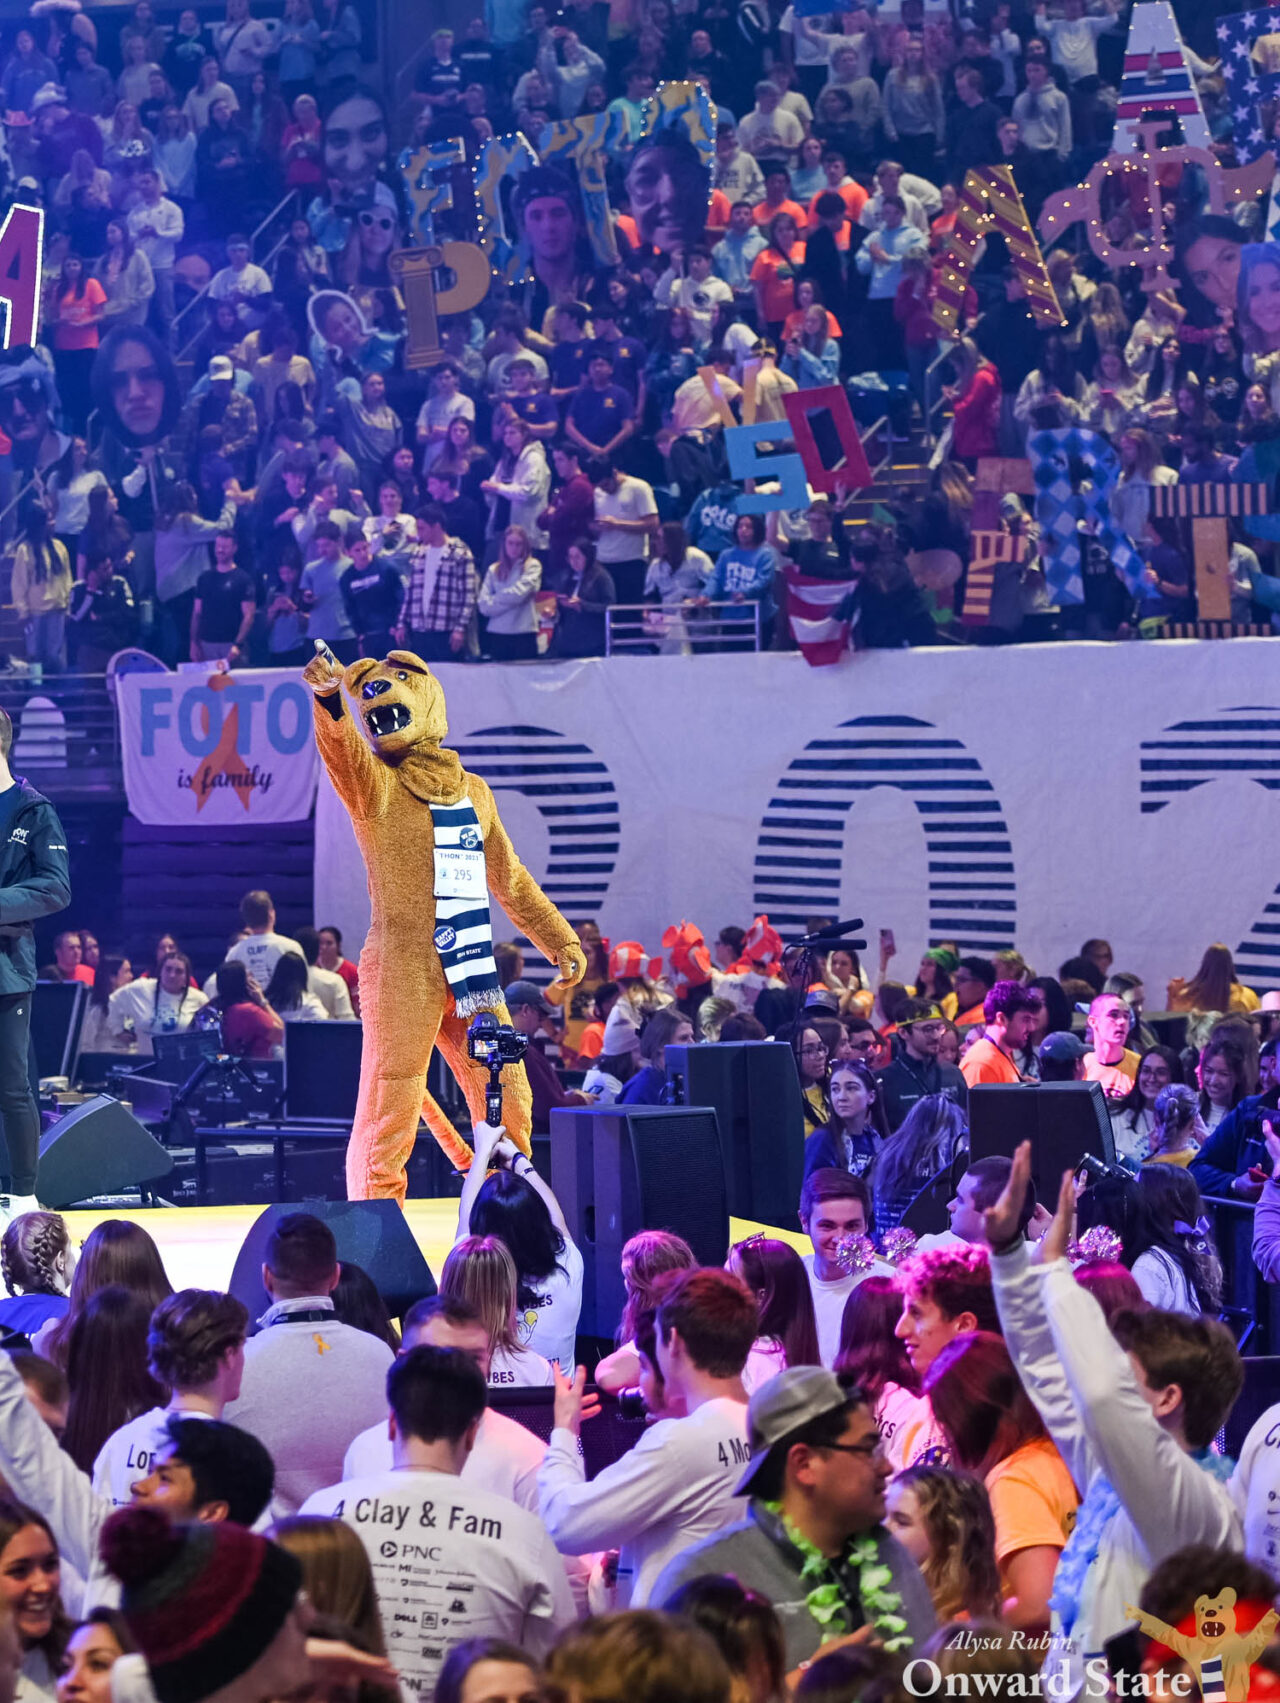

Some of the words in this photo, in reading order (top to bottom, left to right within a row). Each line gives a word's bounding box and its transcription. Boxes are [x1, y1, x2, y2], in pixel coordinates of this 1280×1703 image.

[140, 682, 311, 757] FOTO
[177, 768, 194, 789] is
[200, 764, 273, 796] family
[454, 868, 472, 881] 295
[719, 1441, 729, 1467] 4
[355, 1498, 410, 1532] Clay
[419, 1501, 437, 1529] &
[448, 1505, 503, 1541] Fam
[402, 1544, 443, 1562] PNC
